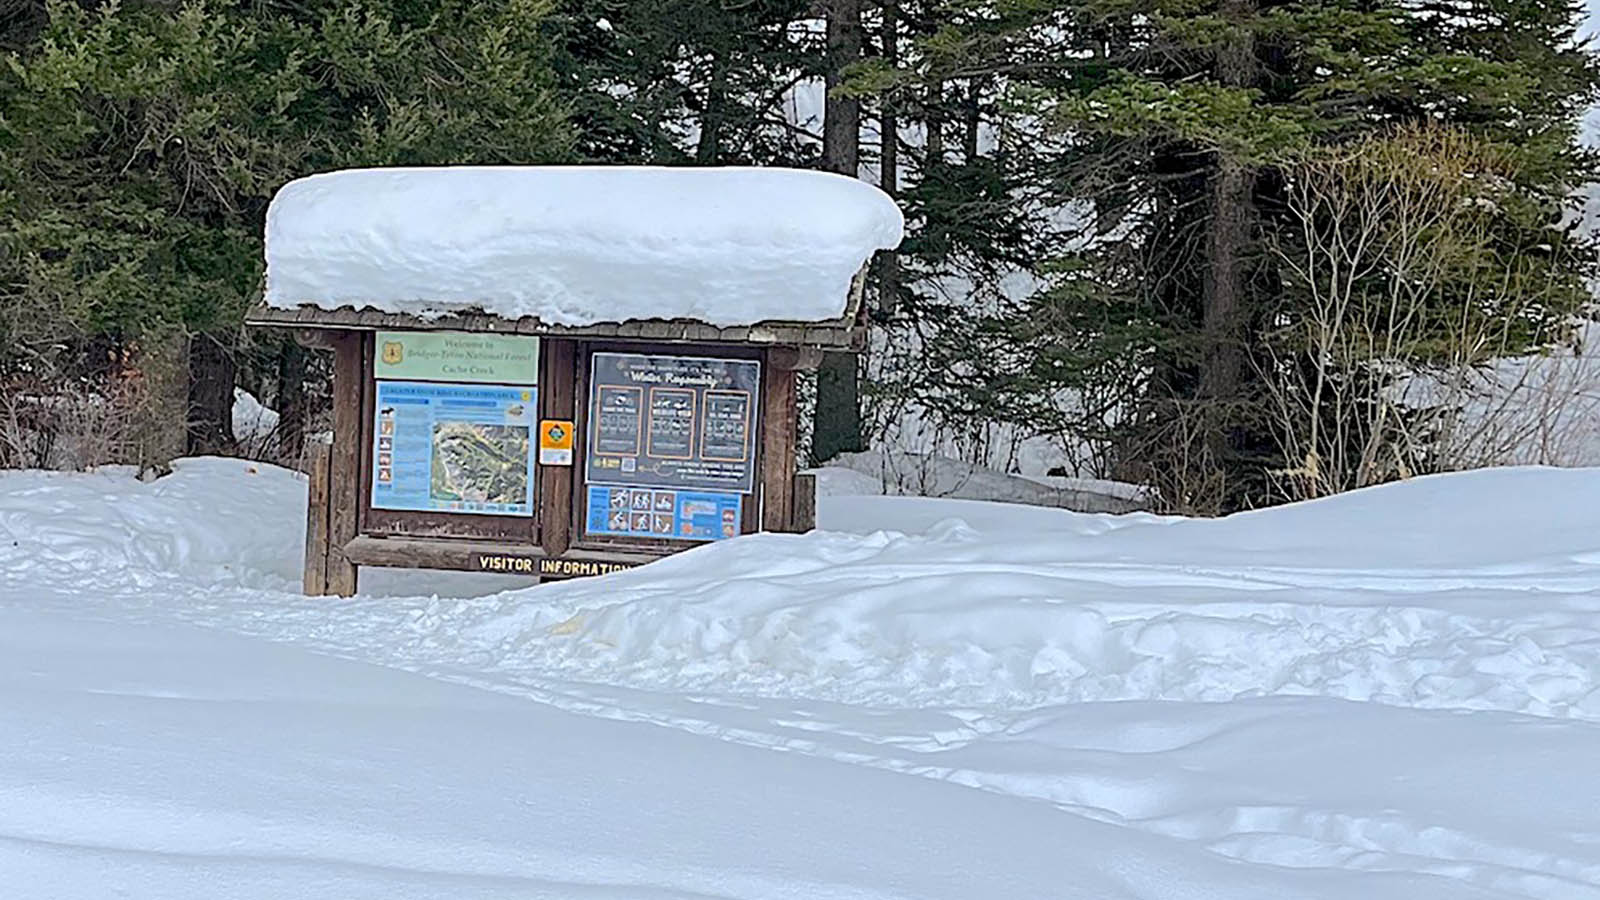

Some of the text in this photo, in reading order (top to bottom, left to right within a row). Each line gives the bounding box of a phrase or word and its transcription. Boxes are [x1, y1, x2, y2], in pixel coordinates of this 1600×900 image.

[444, 339, 483, 349] Welcome
[465, 351, 504, 361] National
[469, 366, 495, 375] Creek
[479, 556, 532, 572] VISITOR
